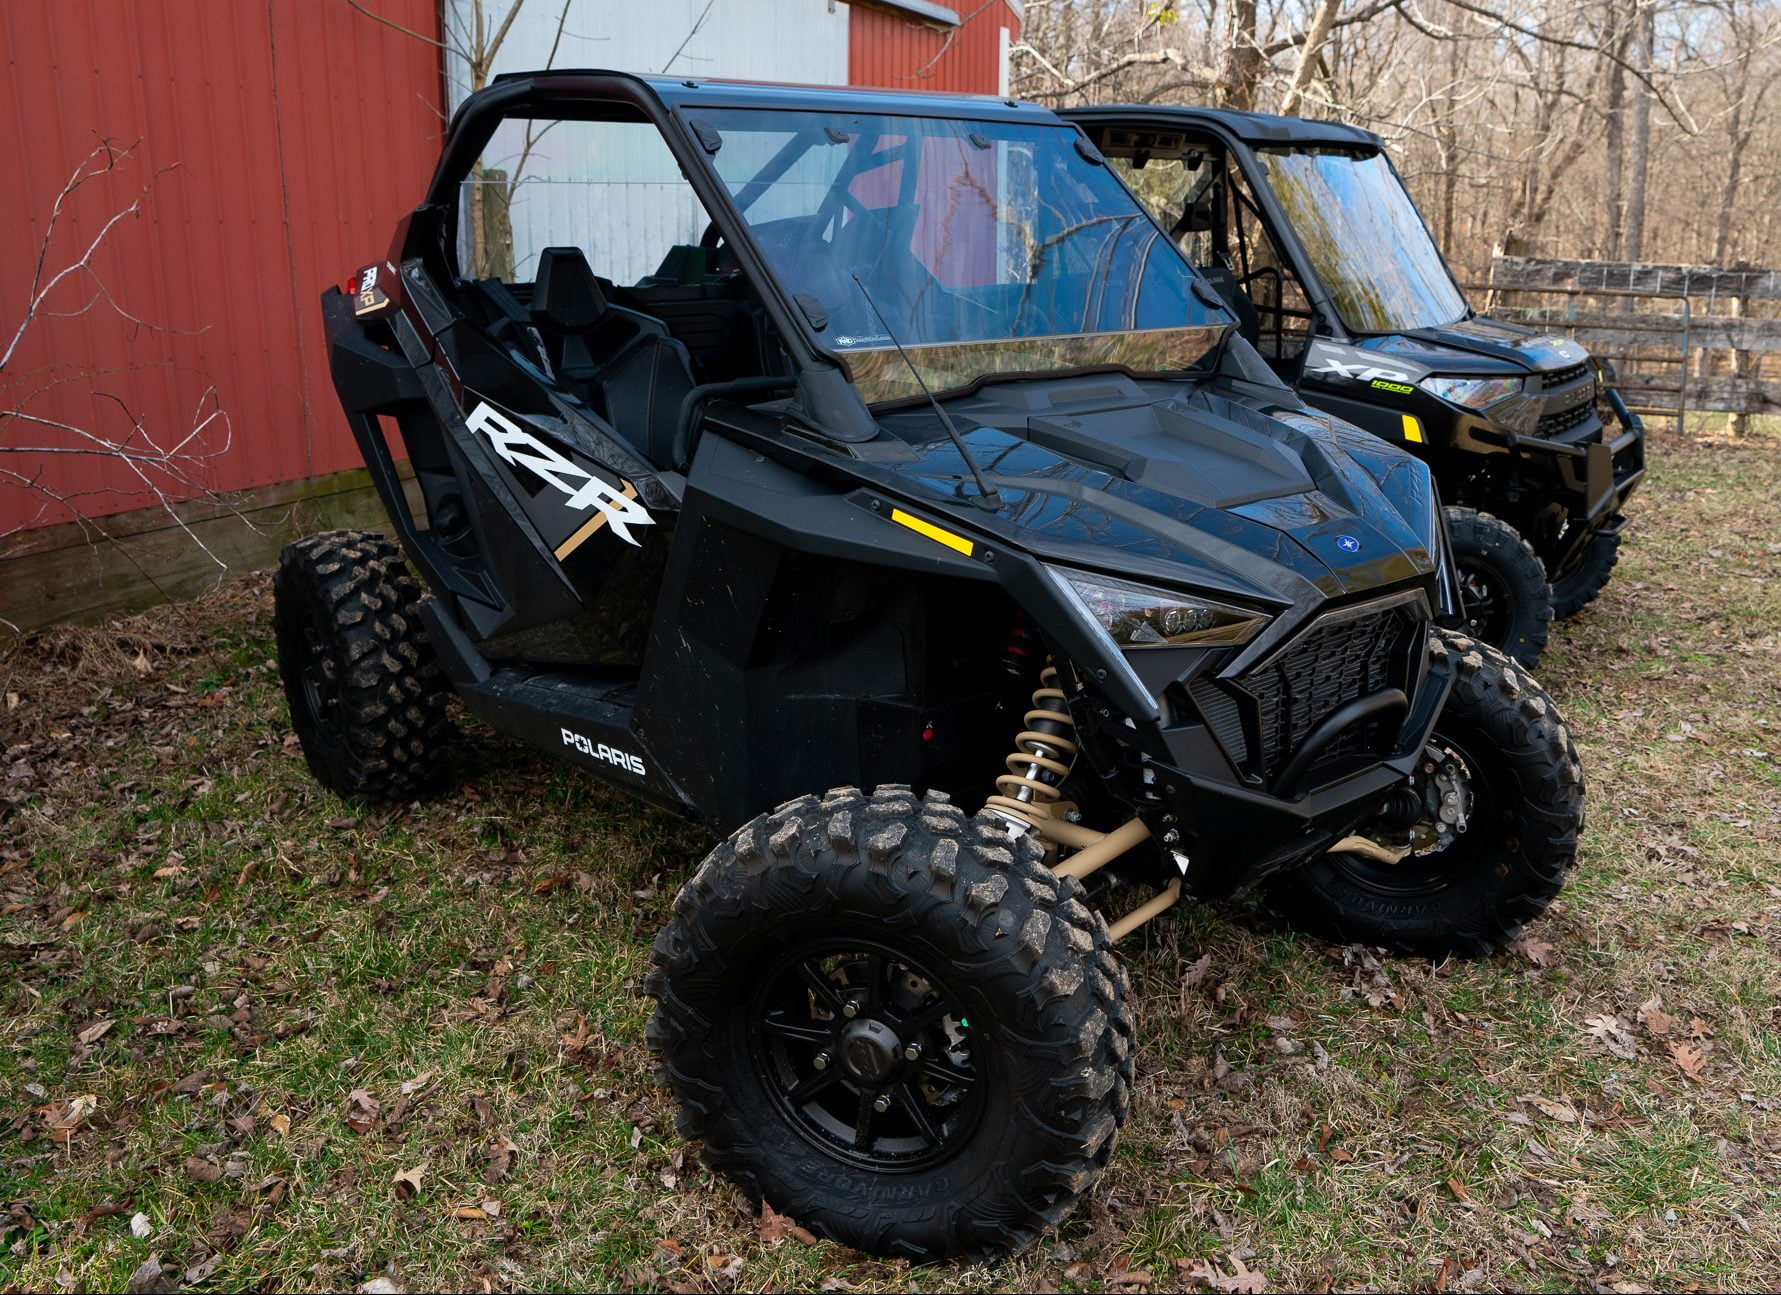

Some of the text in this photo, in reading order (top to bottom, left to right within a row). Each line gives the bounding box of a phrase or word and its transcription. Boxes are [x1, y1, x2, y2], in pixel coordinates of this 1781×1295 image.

[1310, 358, 1408, 382] XP
[1371, 380, 1415, 392] 1000
[465, 401, 657, 547] RZR
[561, 728, 646, 776] POLARIS
